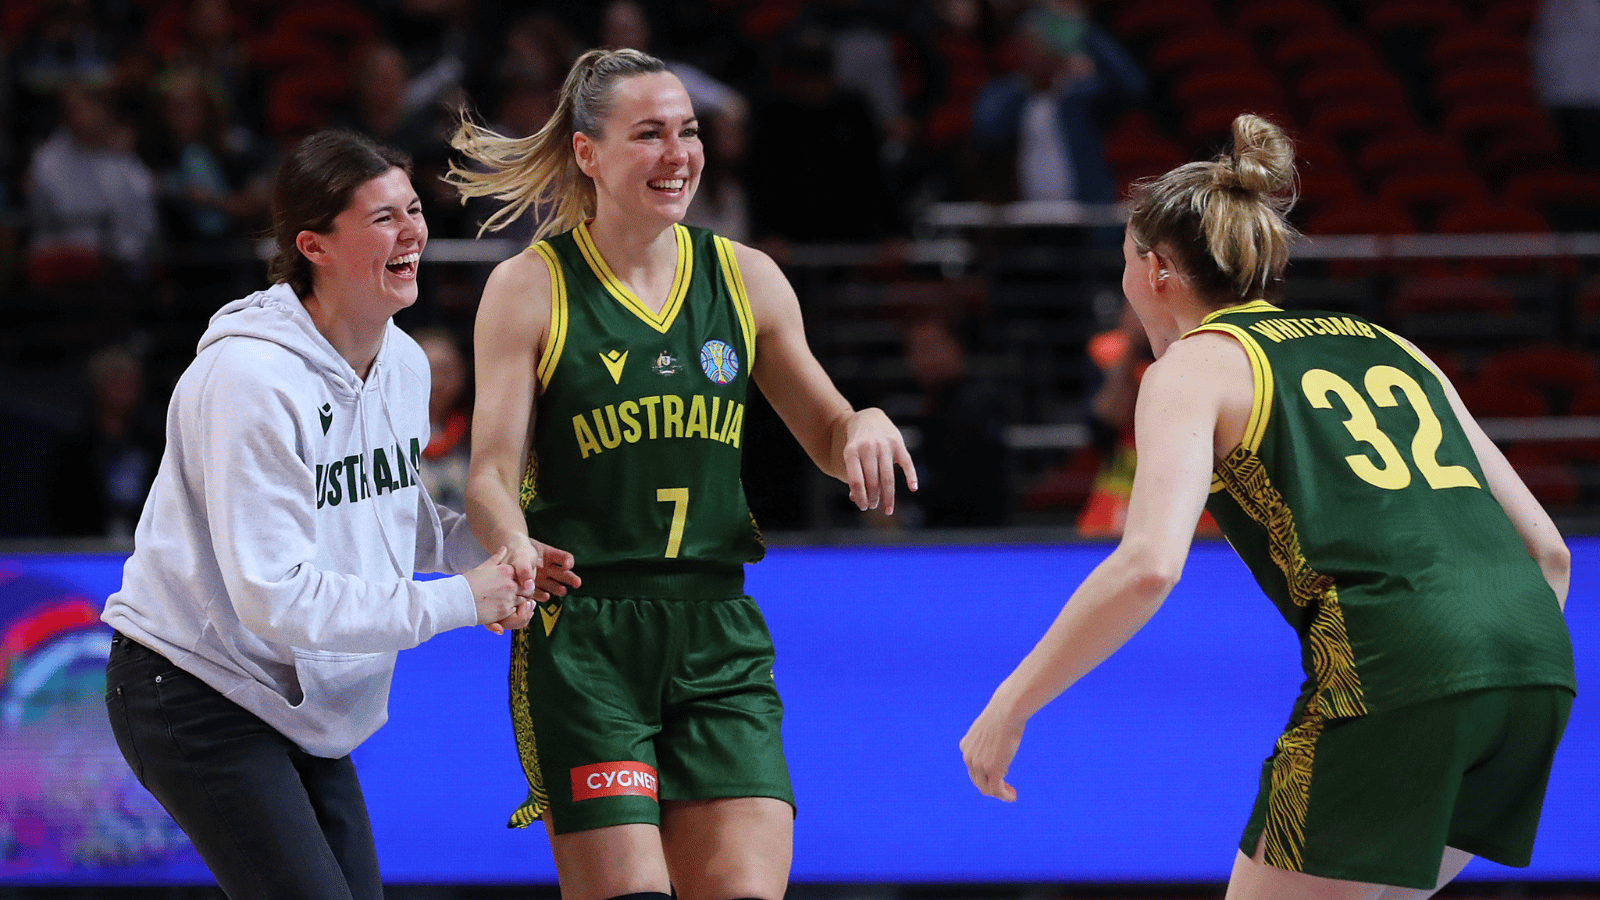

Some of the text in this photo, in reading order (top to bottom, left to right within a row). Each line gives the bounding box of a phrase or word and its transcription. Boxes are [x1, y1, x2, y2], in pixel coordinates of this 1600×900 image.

[1248, 316, 1377, 343] WHITCOMB
[572, 394, 744, 459] AUSTRALIA
[1301, 365, 1482, 490] 32
[656, 487, 689, 558] 7
